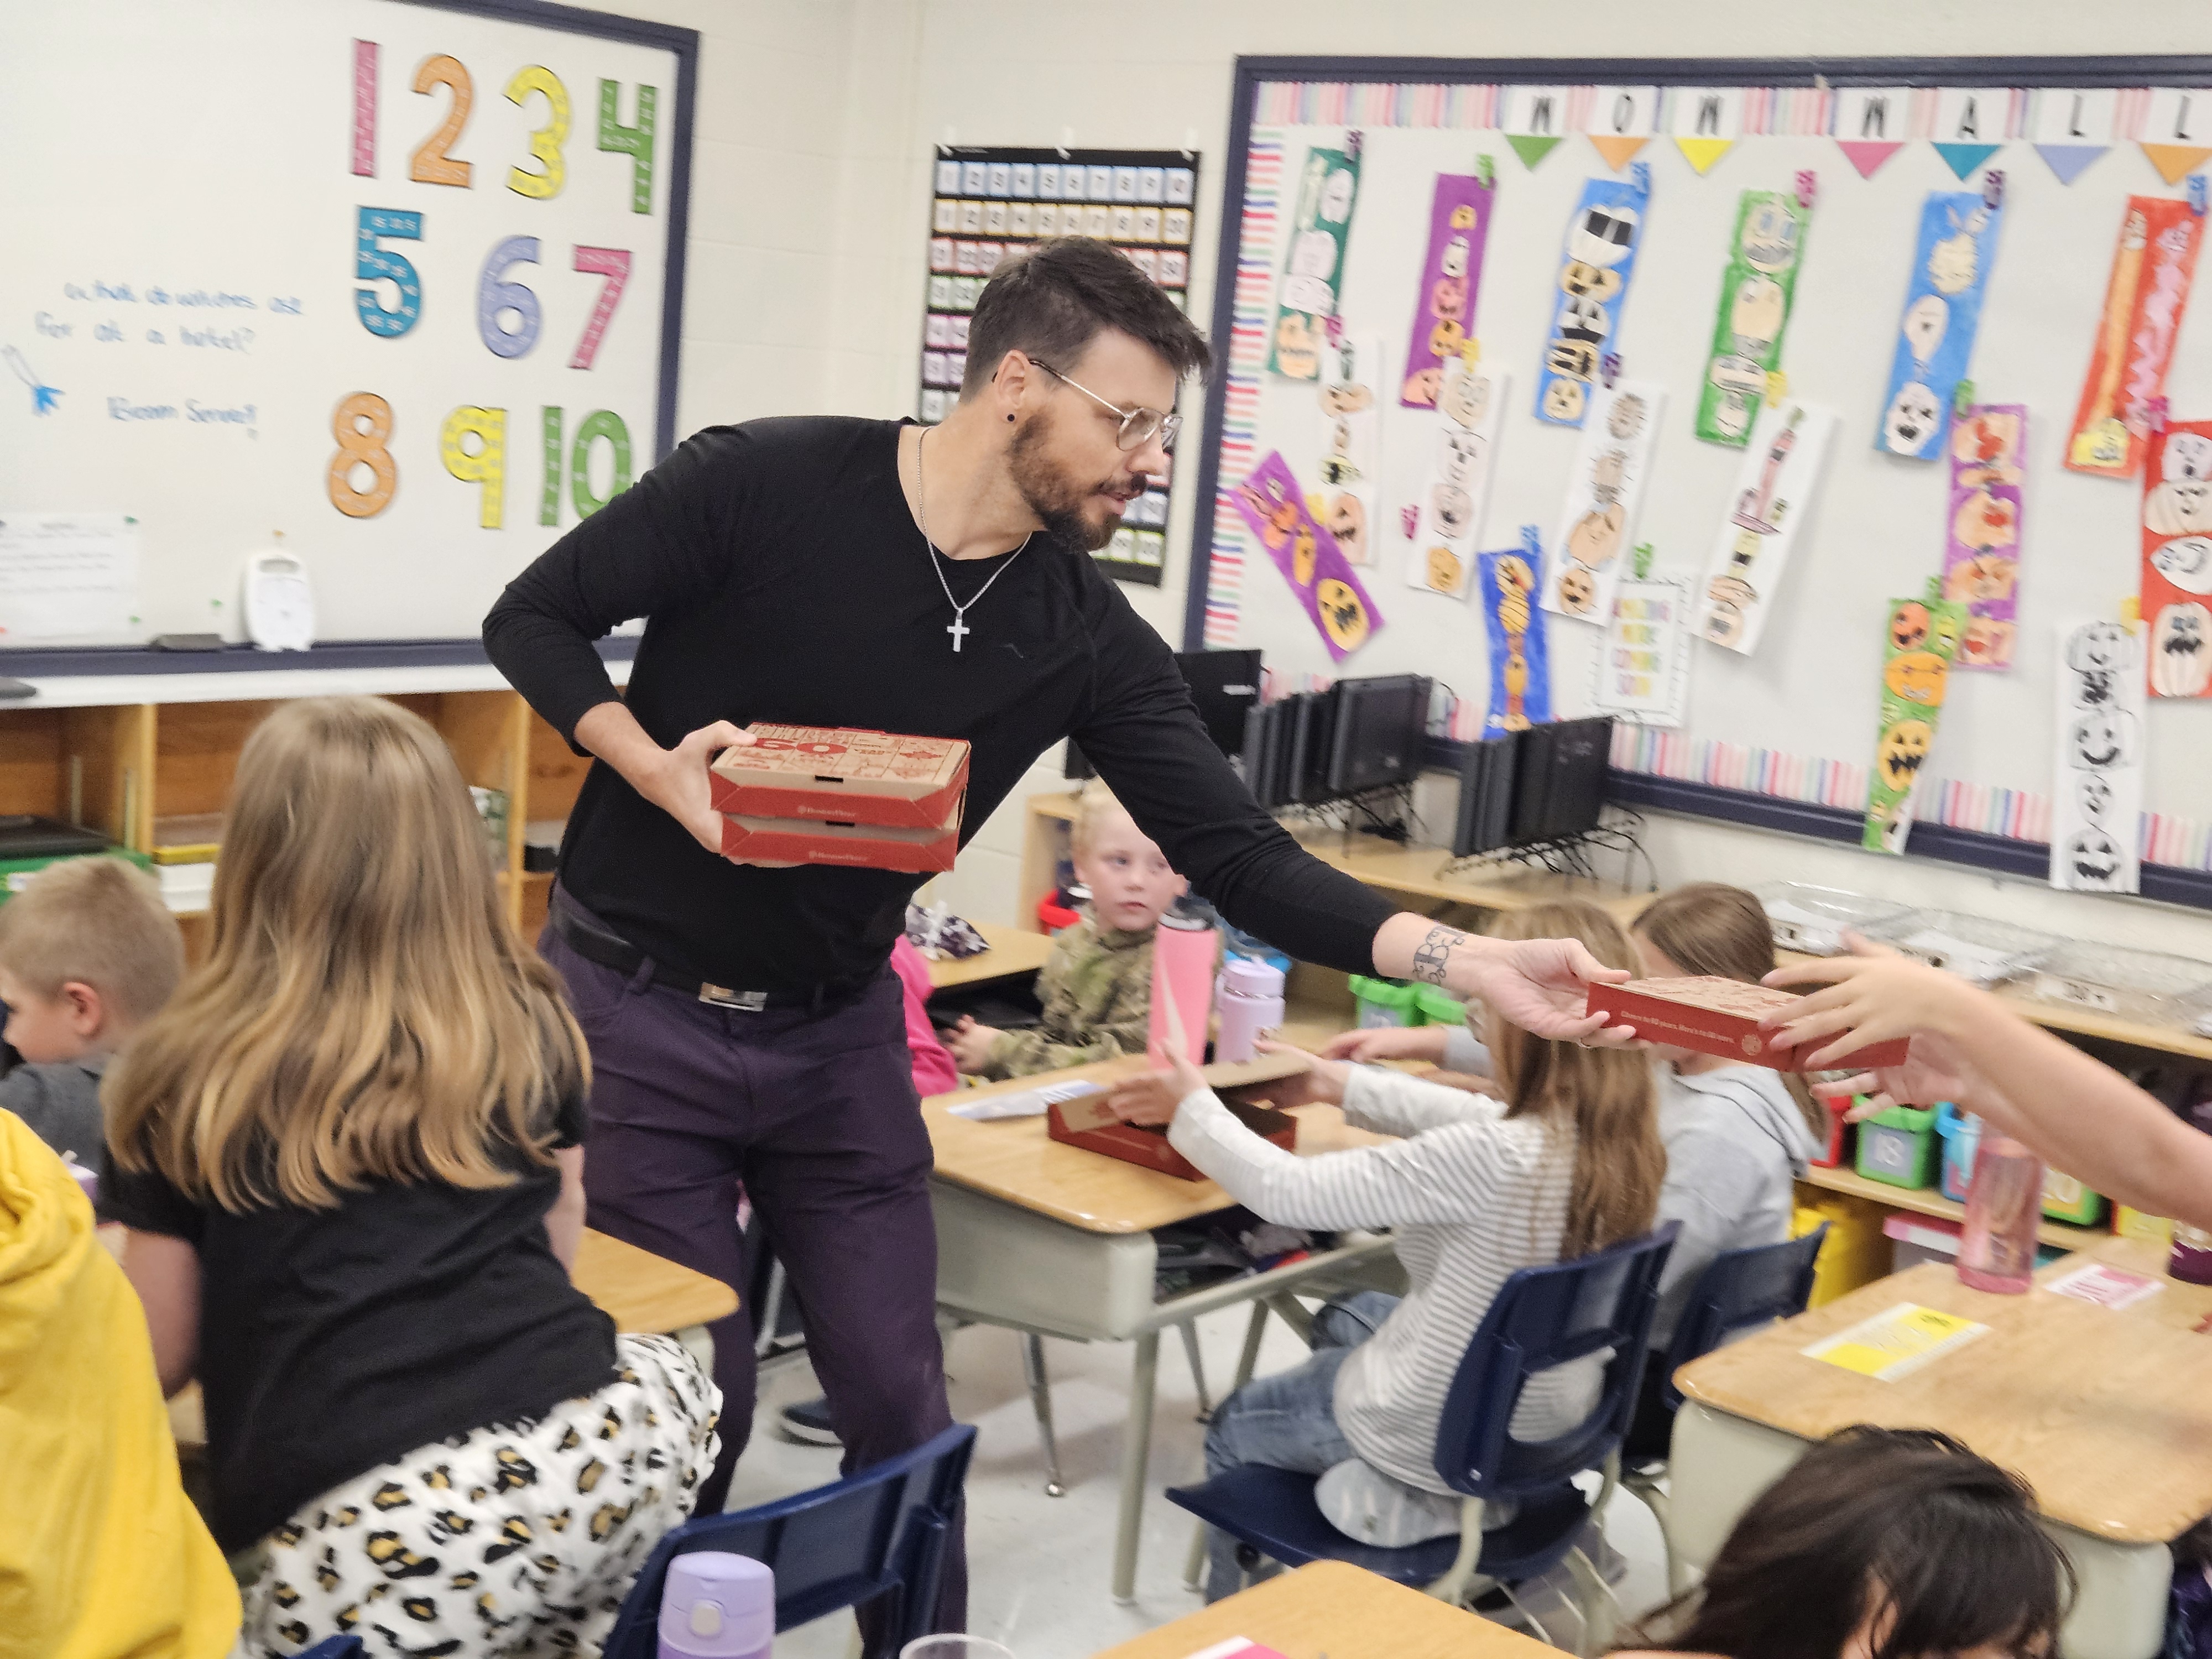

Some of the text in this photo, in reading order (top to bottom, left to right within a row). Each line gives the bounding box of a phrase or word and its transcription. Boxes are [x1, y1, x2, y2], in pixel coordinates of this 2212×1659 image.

[352, 38, 658, 215] 1 2 3 4
[1860, 95, 2192, 140] WALL
[145, 328, 167, 346] a
[354, 205, 633, 370] 5 6 7
[326, 390, 633, 530] 8 9 10
